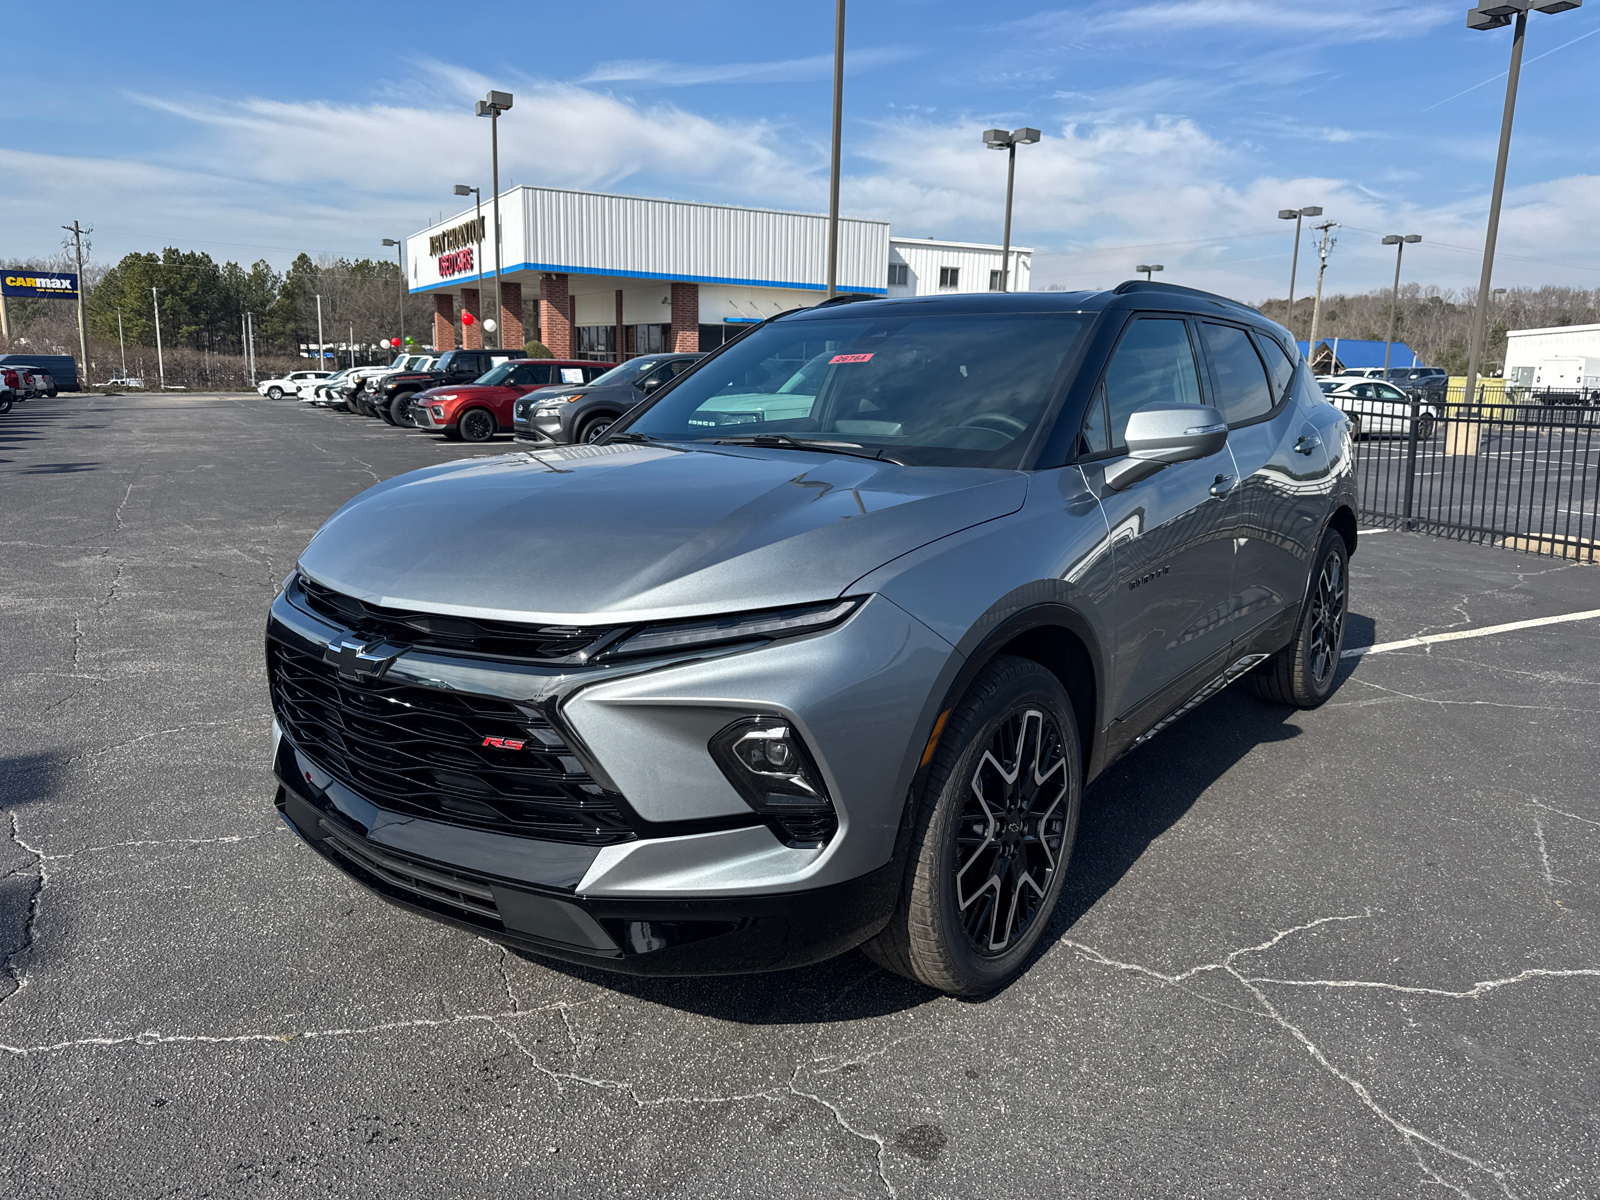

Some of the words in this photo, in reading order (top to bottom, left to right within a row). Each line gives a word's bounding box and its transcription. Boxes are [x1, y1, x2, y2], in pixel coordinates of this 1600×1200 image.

[439, 254, 454, 276] USED
[454, 248, 473, 272] CARS
[688, 419, 716, 427] RONCO
[483, 736, 525, 750] RS
